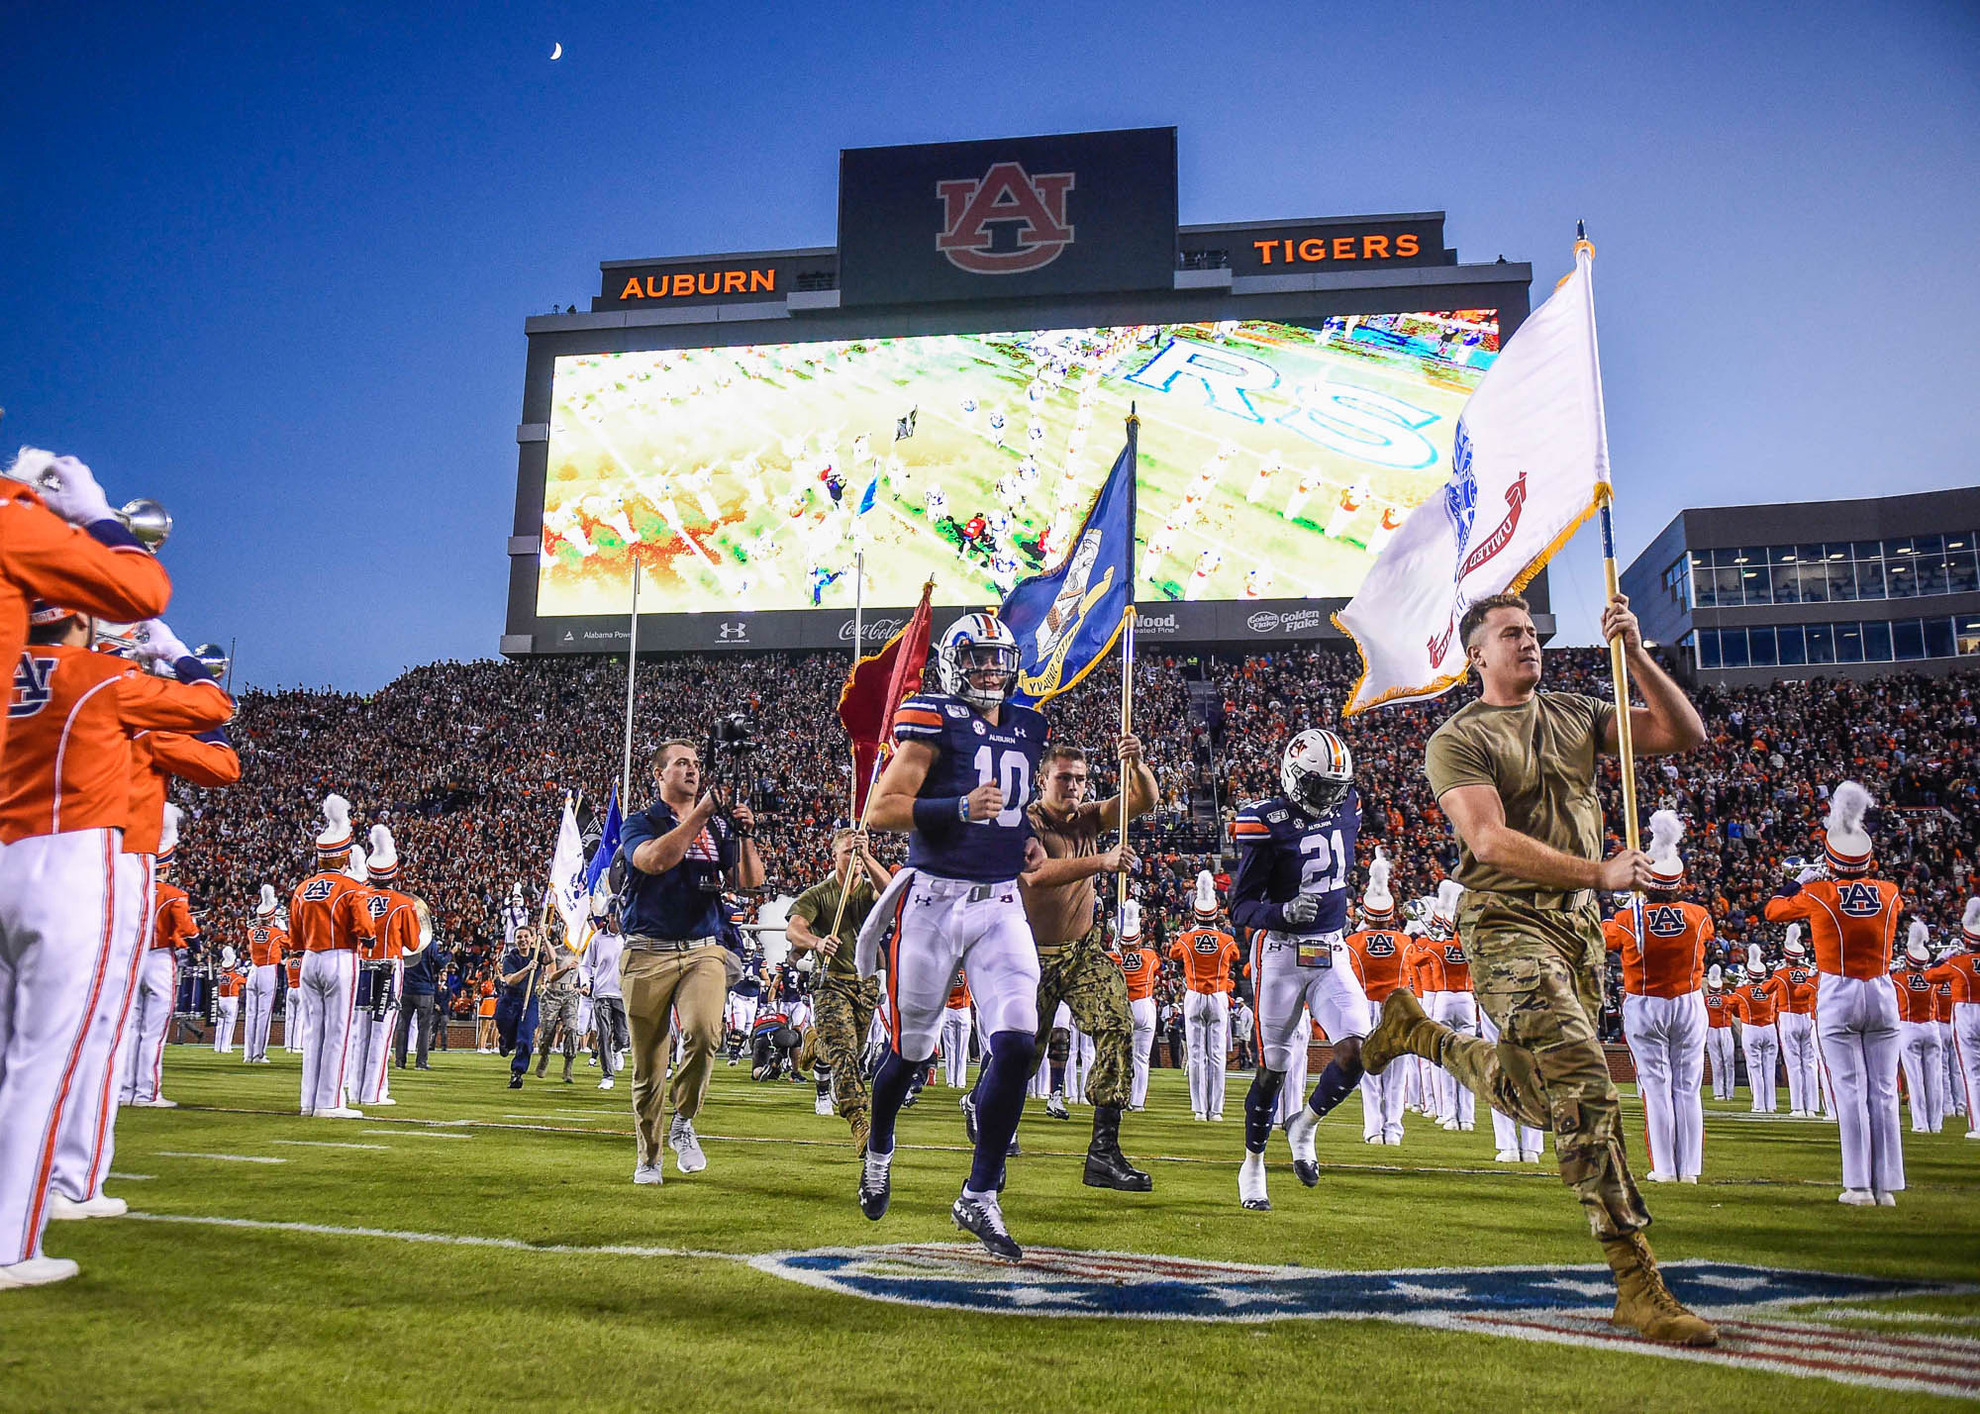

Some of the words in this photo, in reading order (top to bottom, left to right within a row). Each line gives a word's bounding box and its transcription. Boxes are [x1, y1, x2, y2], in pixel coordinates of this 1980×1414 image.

[1253, 234, 1420, 265] TIGERS
[619, 268, 776, 300] AUBURN
[1249, 614, 1277, 624] Golden
[1253, 620, 1277, 629] Flake
[1280, 609, 1320, 623] Golden
[839, 619, 903, 640] Coa-Cola
[1285, 618, 1319, 632] Flake
[584, 631, 613, 639] Alabama
[989, 733, 1016, 745] AUBURN
[974, 745, 1031, 827] 10
[1299, 830, 1347, 893] 21
[1837, 882, 1883, 917] AU
[1646, 906, 1686, 937] AU
[382, 978, 392, 992] VIC
